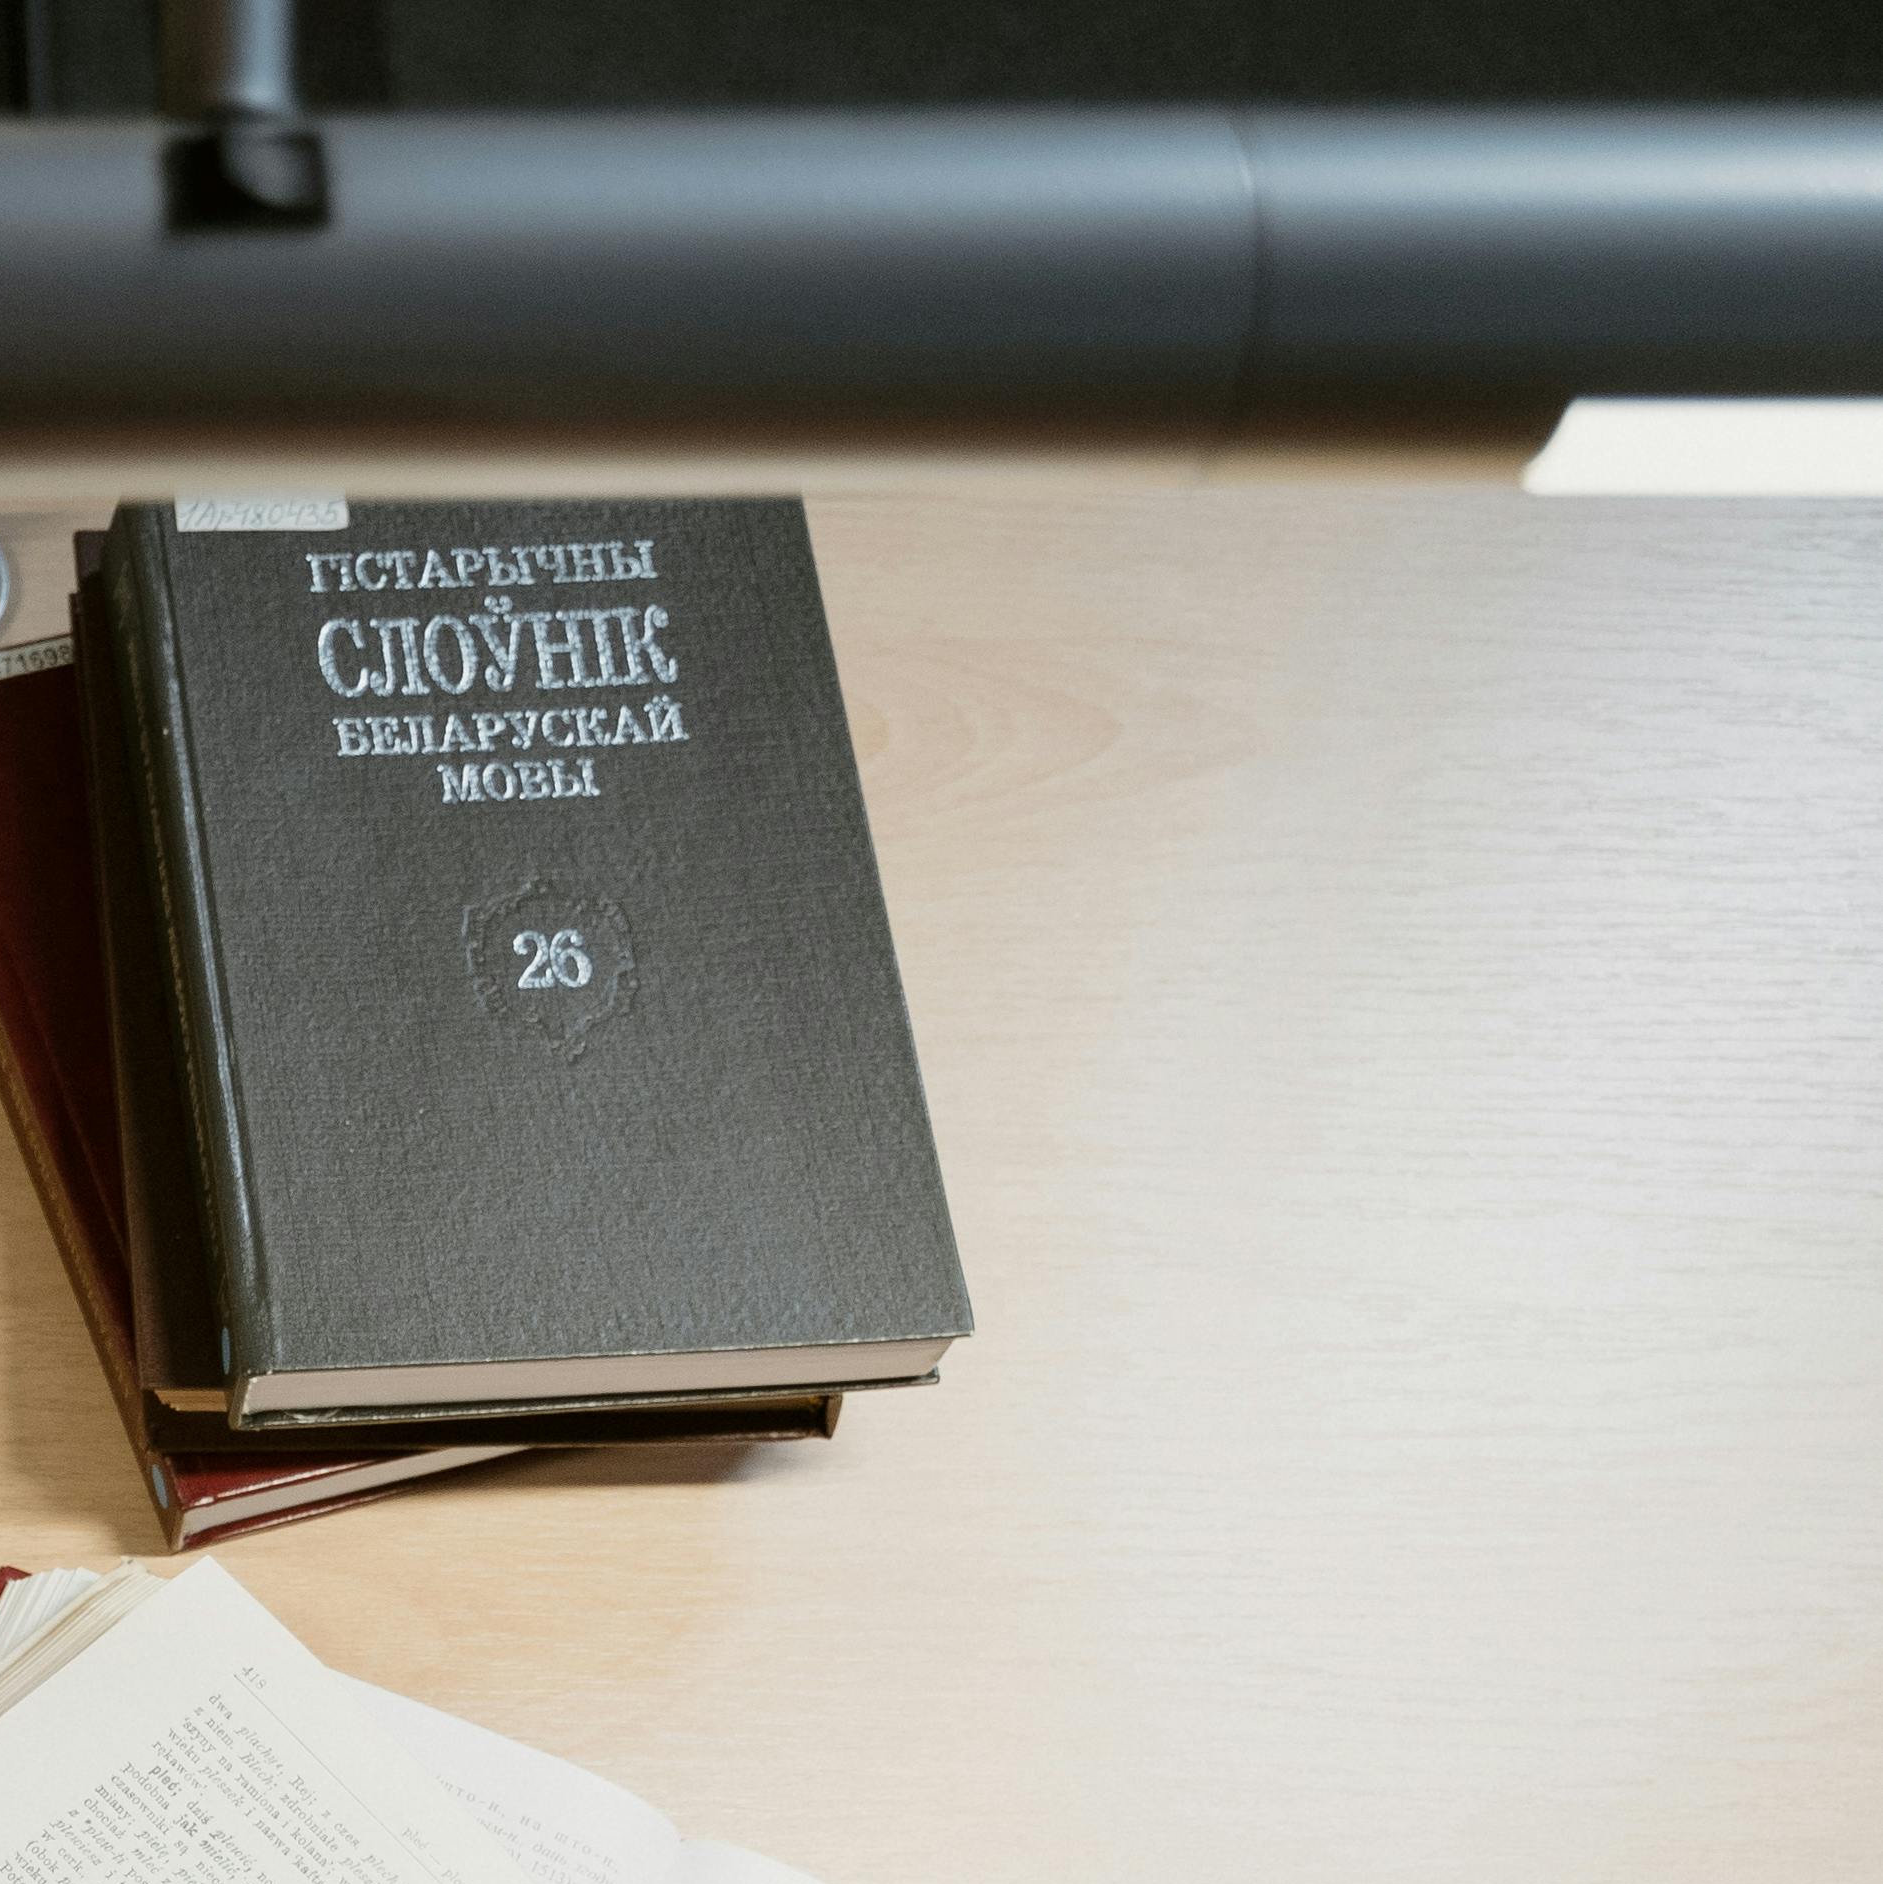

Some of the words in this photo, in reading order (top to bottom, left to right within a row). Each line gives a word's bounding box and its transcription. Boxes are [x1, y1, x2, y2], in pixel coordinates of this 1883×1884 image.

[317, 594, 681, 698] СЛОЎНІК
[332, 694, 691, 757] БЕЛАРУСКАЙ
[436, 756, 601, 804] МОВЫ
[510, 930, 594, 990] 26
[241, 1666, 267, 1689] 418
